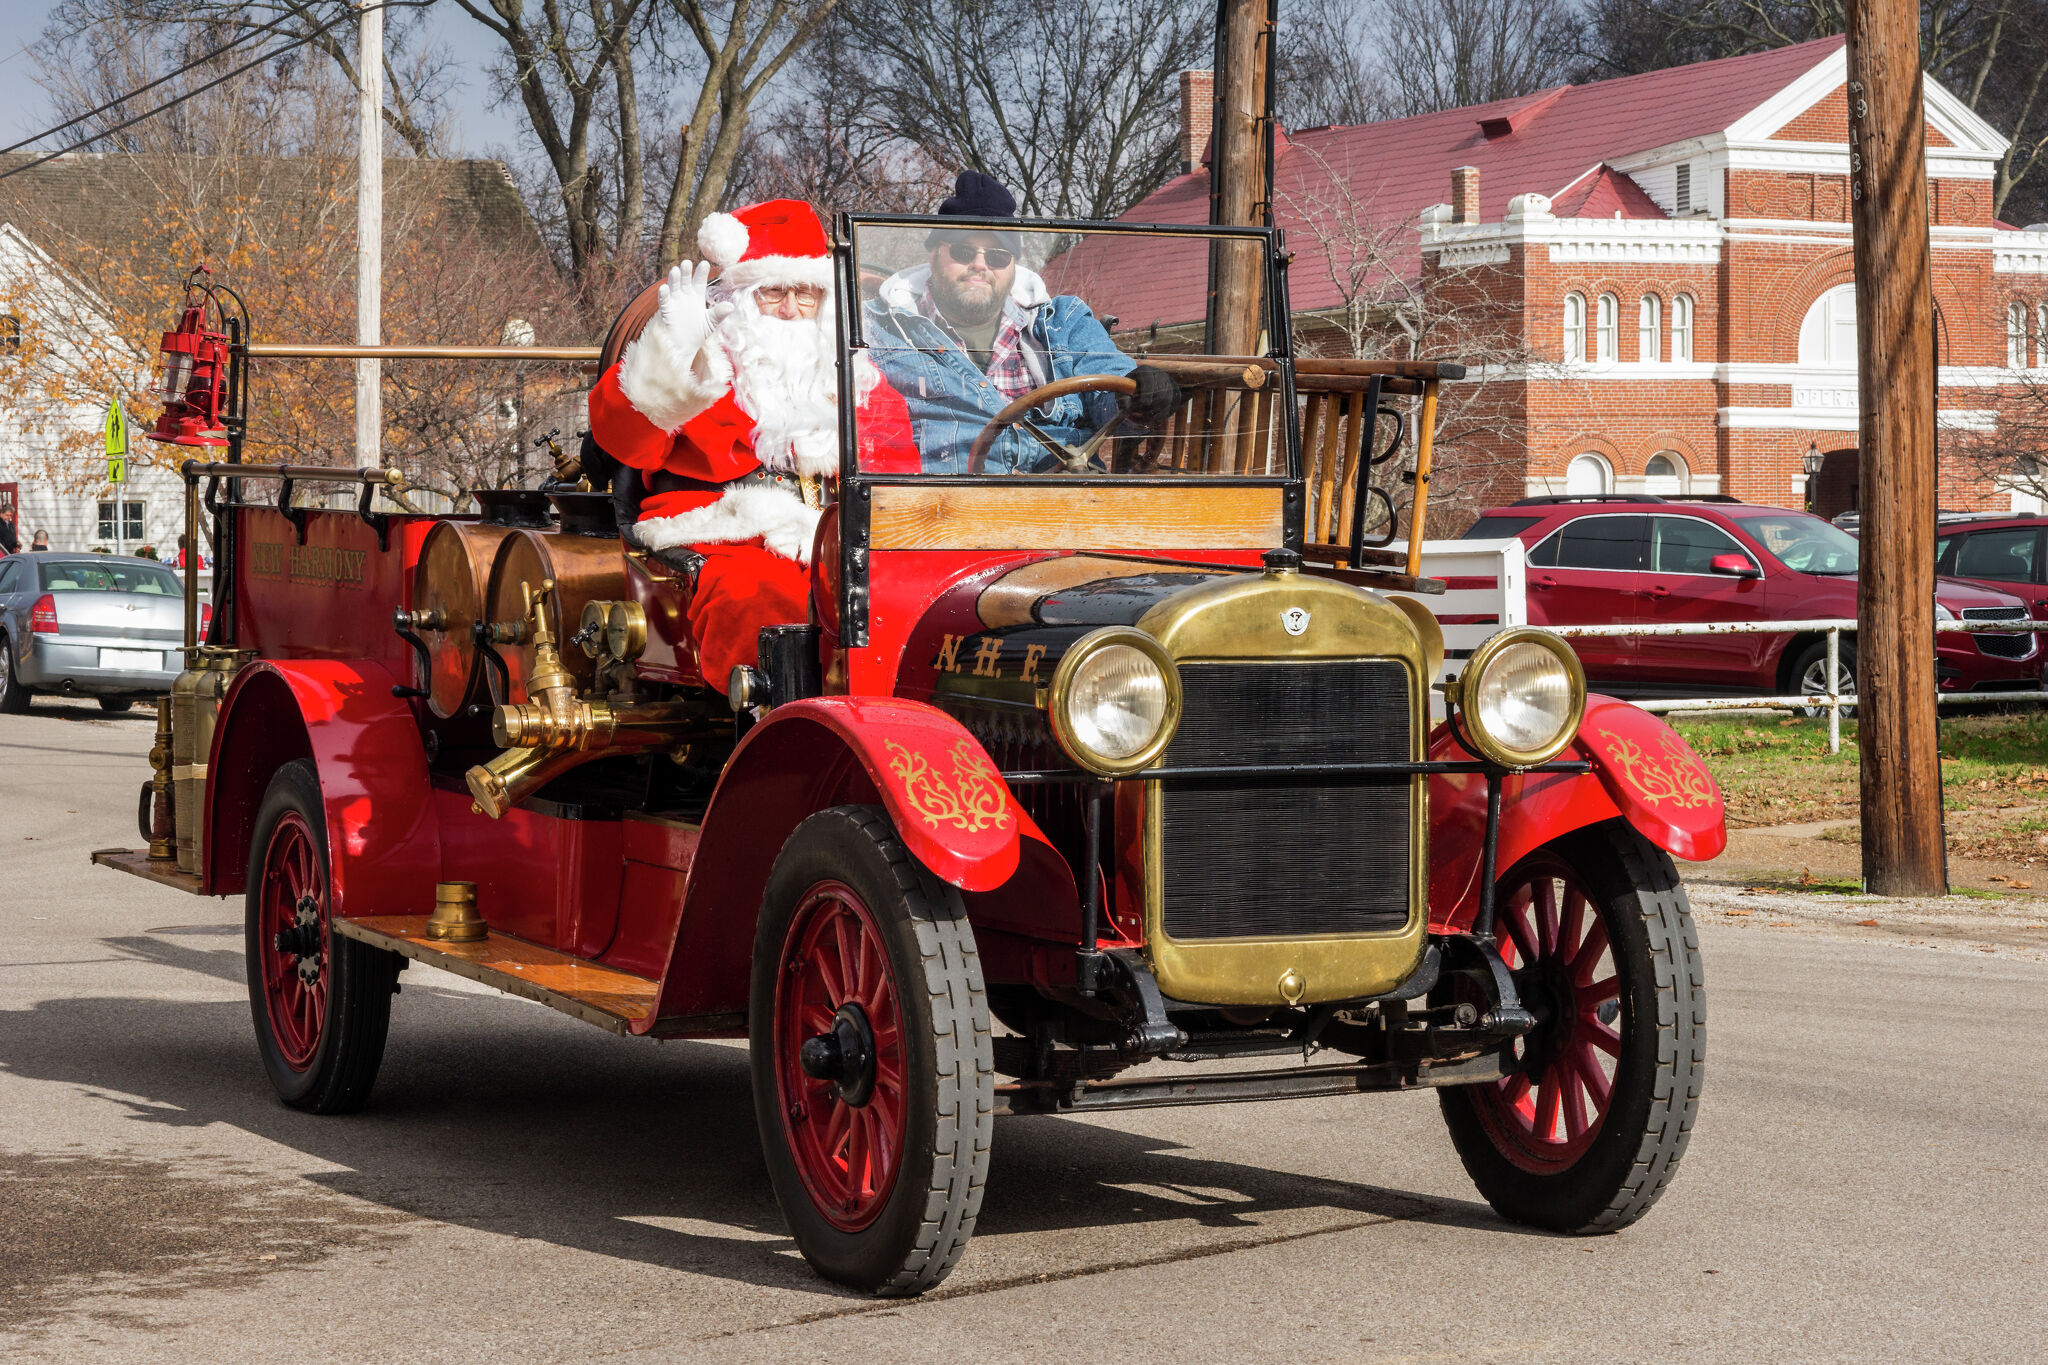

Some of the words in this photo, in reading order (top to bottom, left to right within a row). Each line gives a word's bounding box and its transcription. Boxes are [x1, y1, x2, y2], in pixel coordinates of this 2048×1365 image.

[1796, 390, 1856, 407] OPERA
[252, 542, 283, 574] NEW
[290, 545, 366, 582] HARMONY
